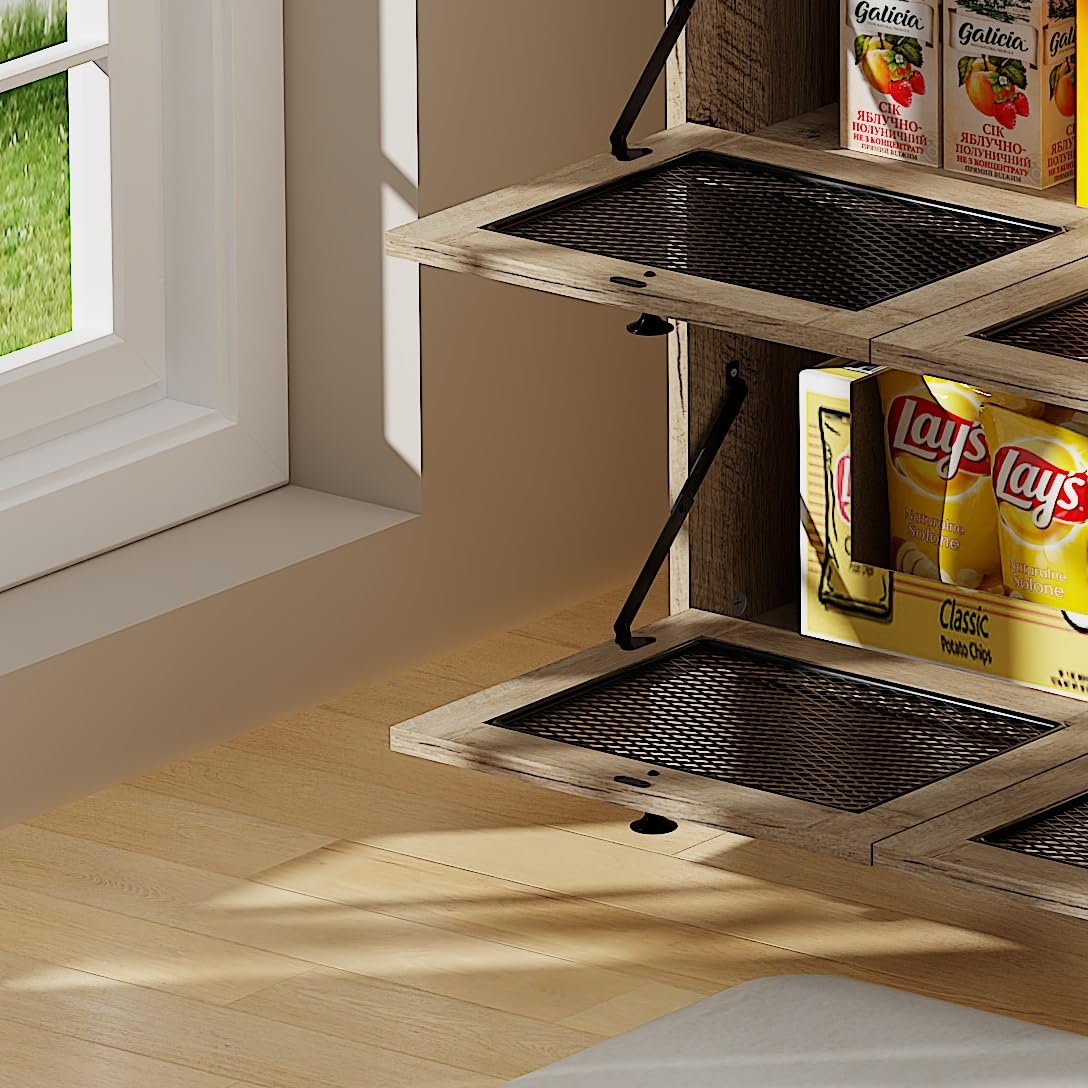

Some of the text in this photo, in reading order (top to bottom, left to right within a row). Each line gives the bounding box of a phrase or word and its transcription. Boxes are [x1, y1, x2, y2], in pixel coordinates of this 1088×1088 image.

[854, 0, 925, 30] Galicia
[958, 22, 1029, 52] Galicia
[857, 110, 923, 132] ЯБЛУЧНО-
[879, 101, 901, 116] СІК
[960, 132, 1027, 155] ЯБЛУЧНО-
[982, 123, 1005, 138] СІК
[893, 398, 987, 480] Lay's
[996, 448, 1086, 529] Lay's
[1013, 573, 1065, 599] Solone
[939, 597, 990, 639] Classic
